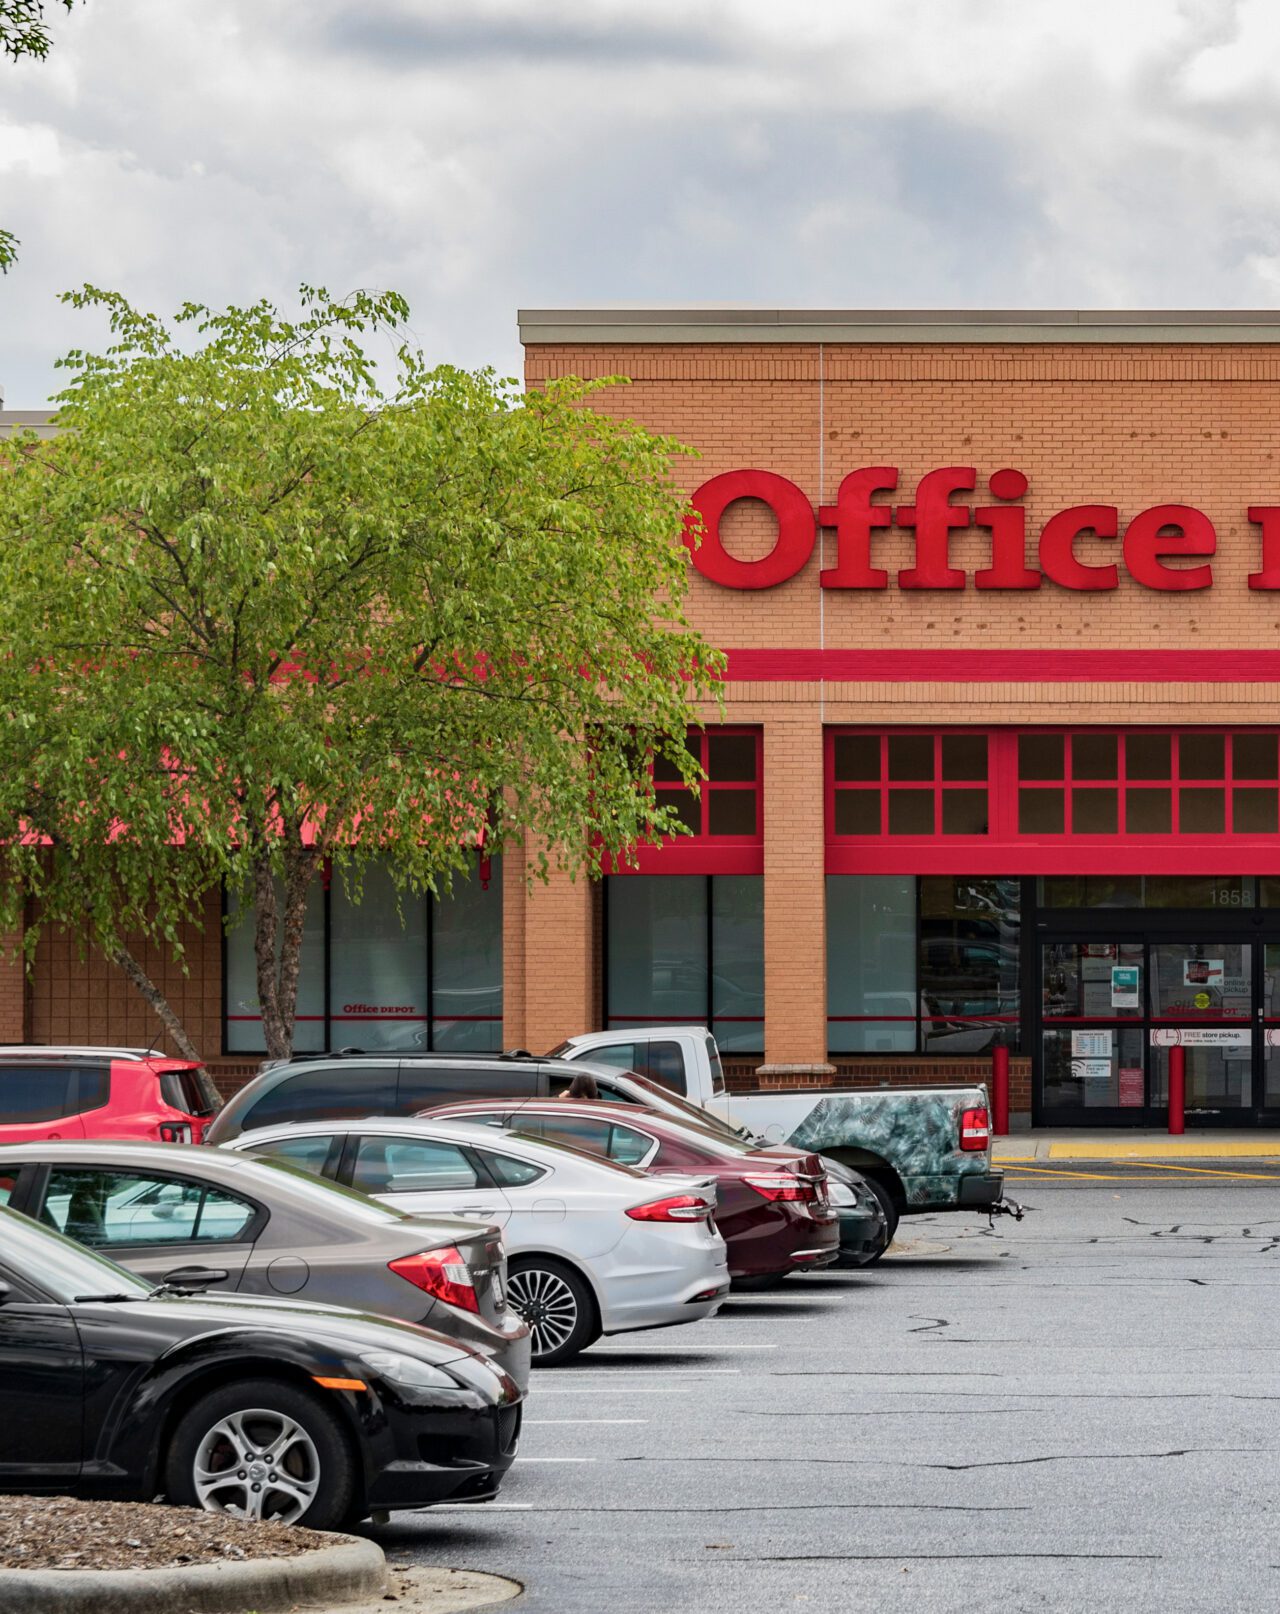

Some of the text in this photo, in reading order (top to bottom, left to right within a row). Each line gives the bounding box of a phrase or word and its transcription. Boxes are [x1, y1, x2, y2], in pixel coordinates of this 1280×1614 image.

[682, 467, 1218, 592] Office
[1209, 889, 1251, 904] 1858
[343, 1003, 379, 1013] Office
